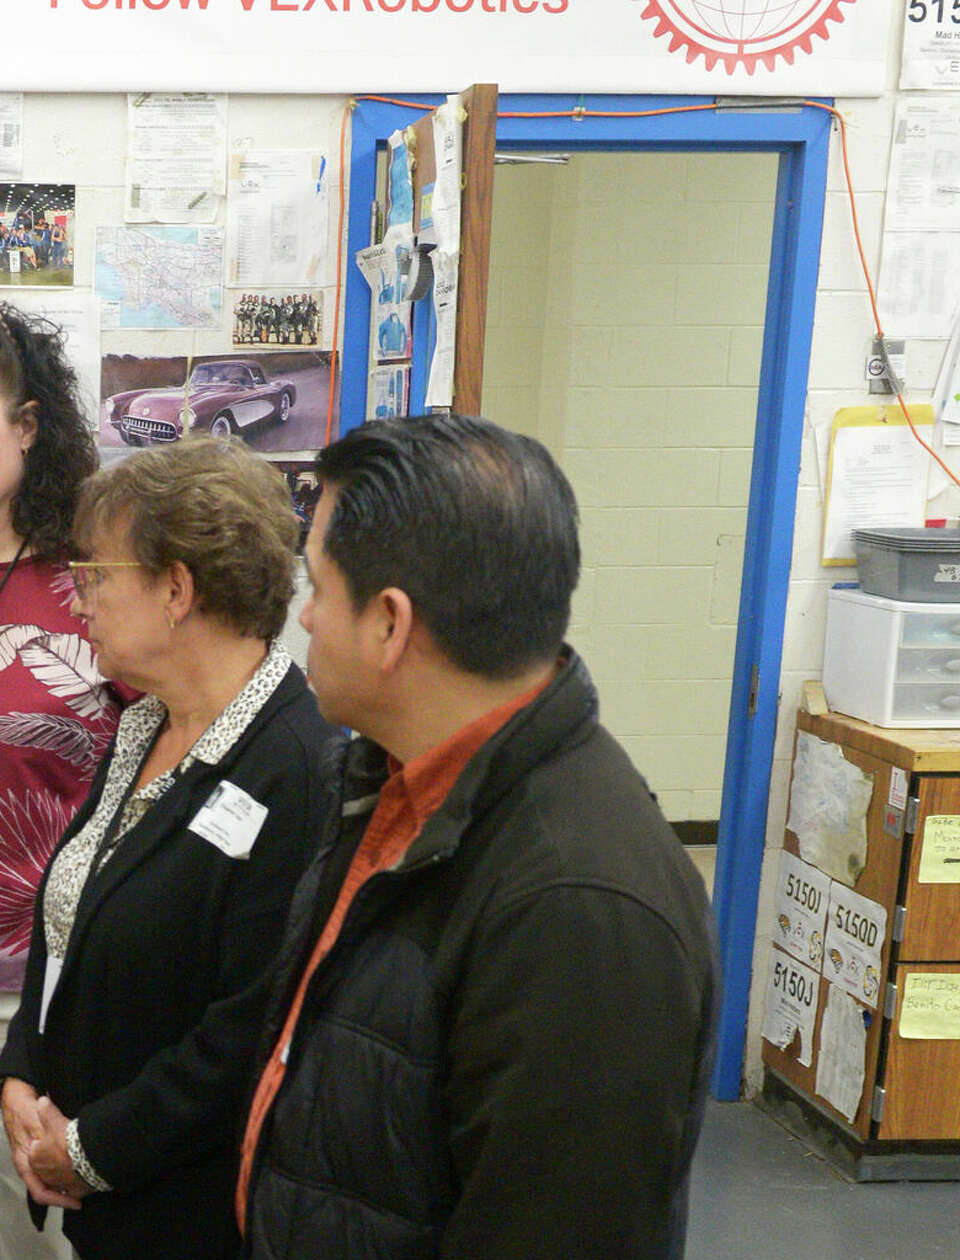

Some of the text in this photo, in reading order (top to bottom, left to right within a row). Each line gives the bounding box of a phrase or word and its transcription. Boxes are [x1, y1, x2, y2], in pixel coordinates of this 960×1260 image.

[786, 873, 822, 914] 5150J
[835, 904, 878, 947] 5150D
[773, 961, 814, 1007] 5150J
